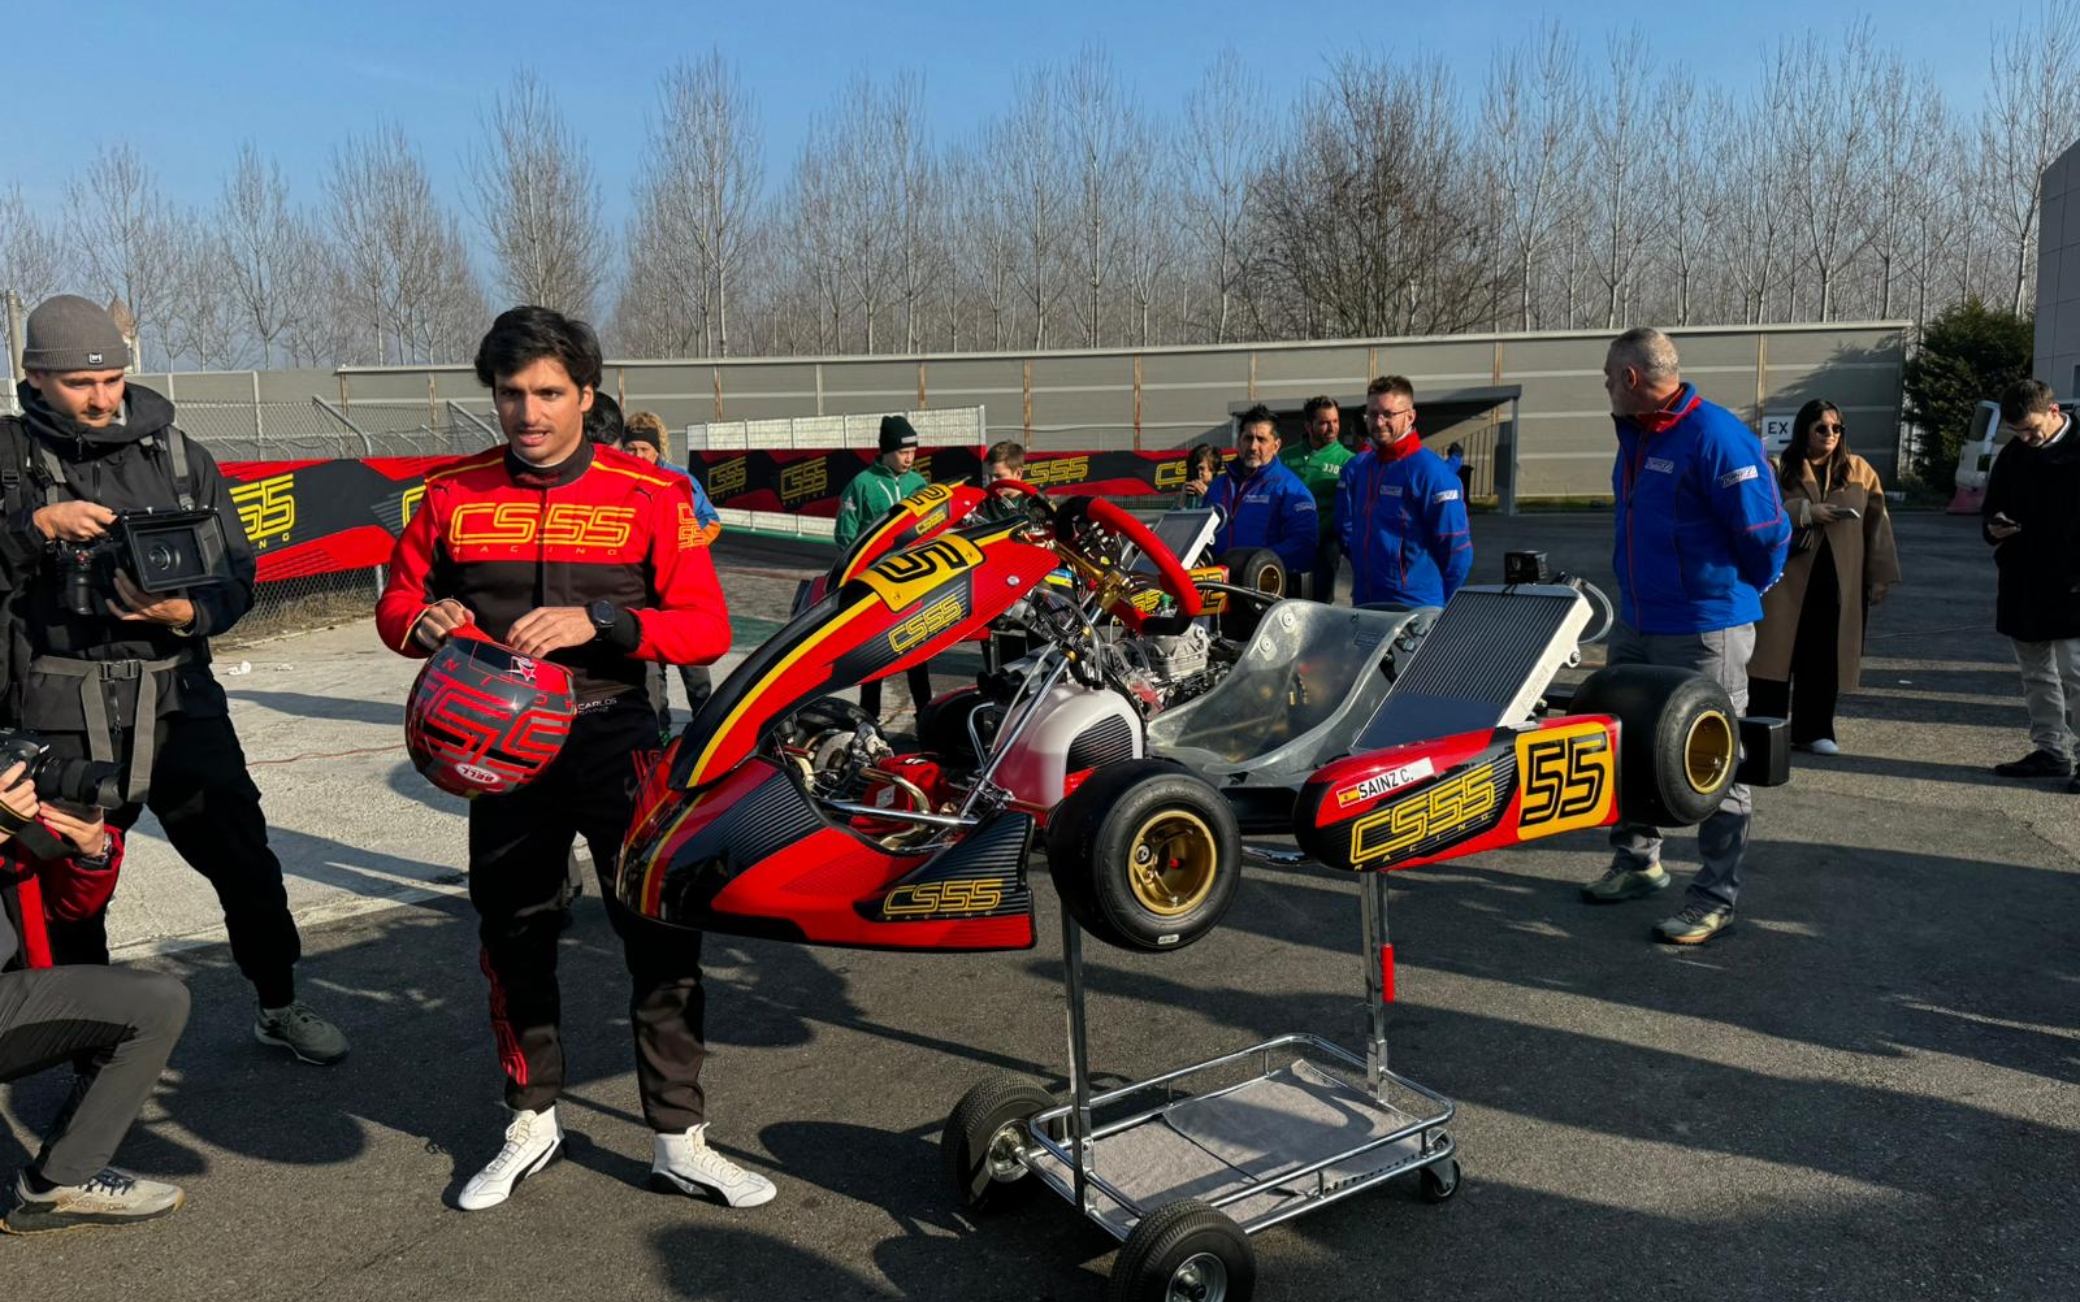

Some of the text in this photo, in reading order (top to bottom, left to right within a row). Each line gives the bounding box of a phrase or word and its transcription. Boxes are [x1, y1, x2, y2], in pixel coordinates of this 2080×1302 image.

[577, 698, 617, 711] CARLOS
[462, 767, 495, 783] BELL
[1357, 772, 1400, 800] SAINZ
[1519, 732, 1607, 827] 55
[1351, 764, 1495, 865] CS55
[1353, 813, 1489, 872] RACING
[883, 879, 1003, 915] CS55
